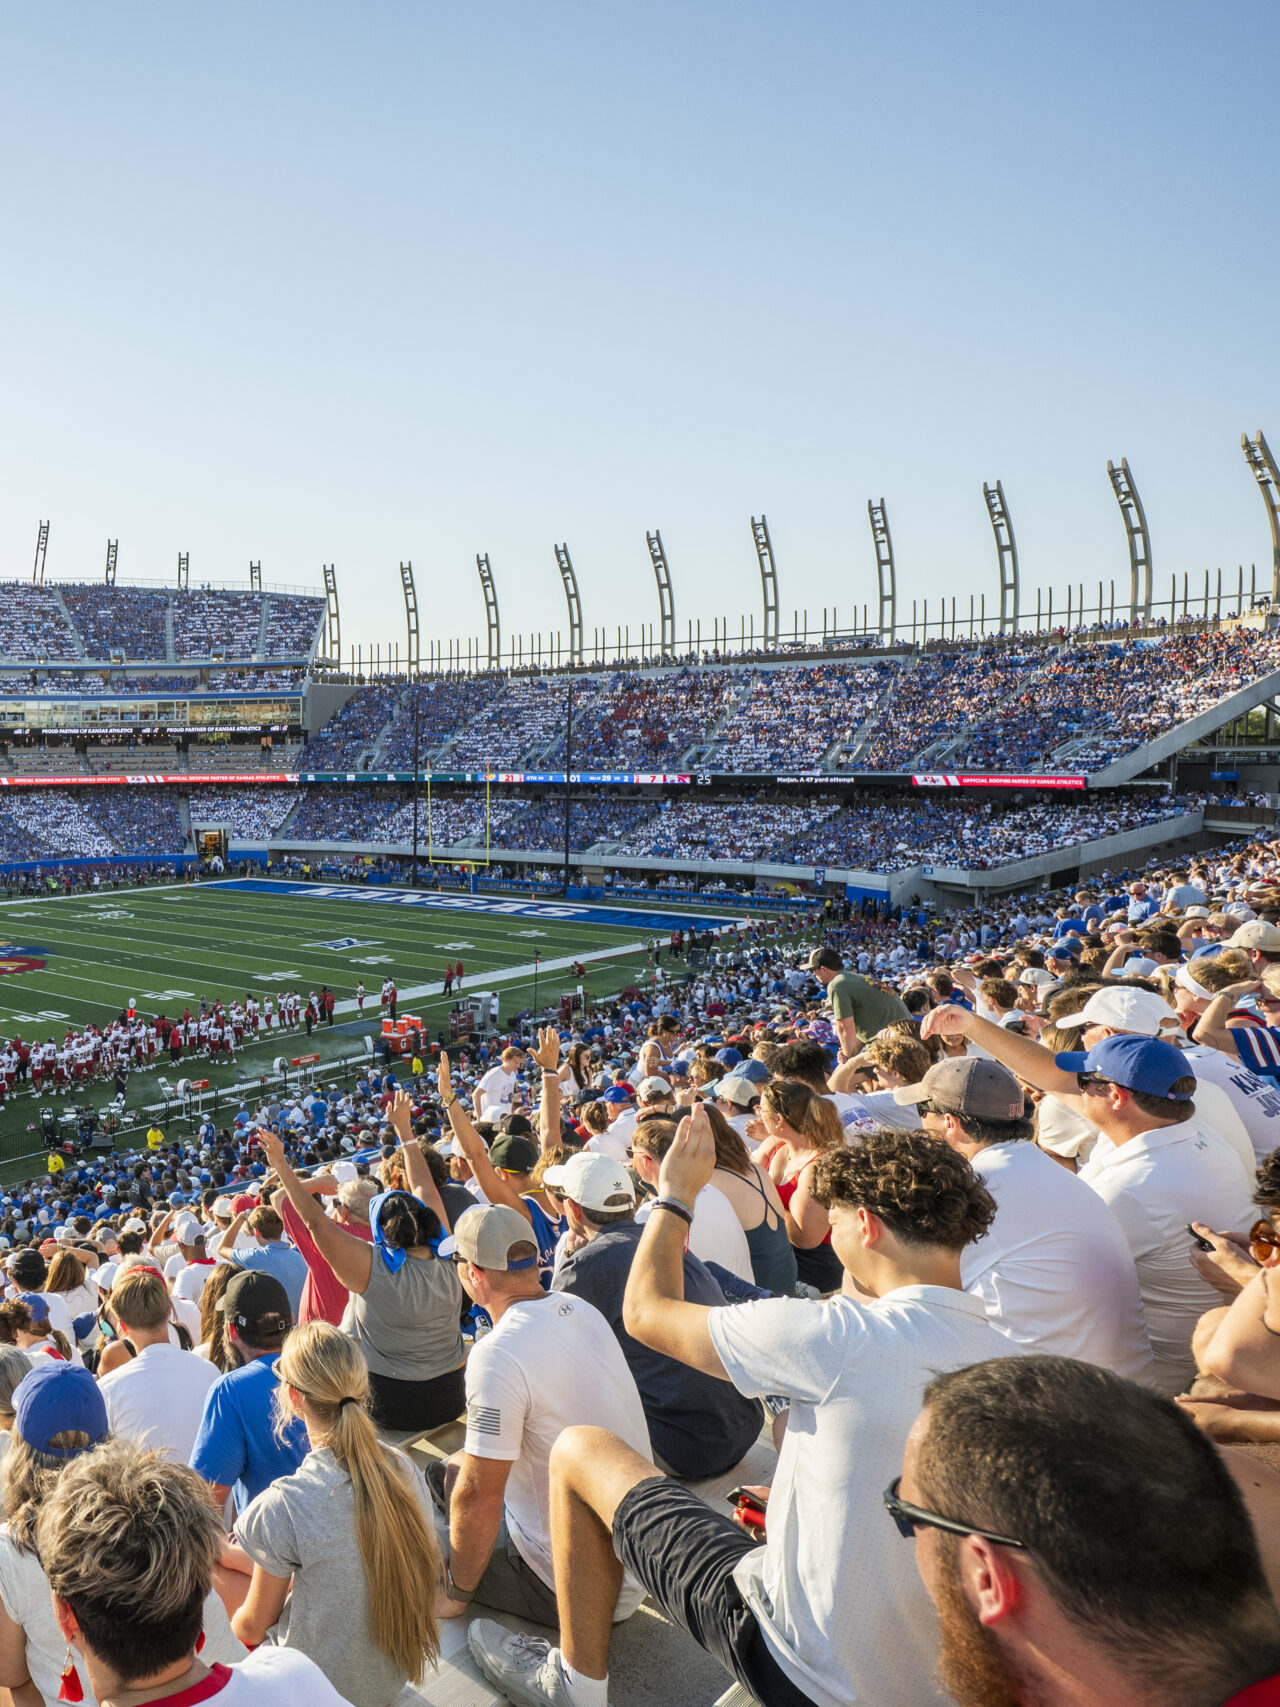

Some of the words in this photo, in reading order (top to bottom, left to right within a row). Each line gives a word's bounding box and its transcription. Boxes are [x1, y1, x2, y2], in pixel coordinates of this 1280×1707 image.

[698, 775, 710, 784] 25
[289, 886, 590, 918] KANSAS
[140, 990, 196, 1000] 50
[11, 1010, 71, 1023] 40
[400, 1038, 407, 1048] G
[1009, 1104, 1023, 1117] KU
